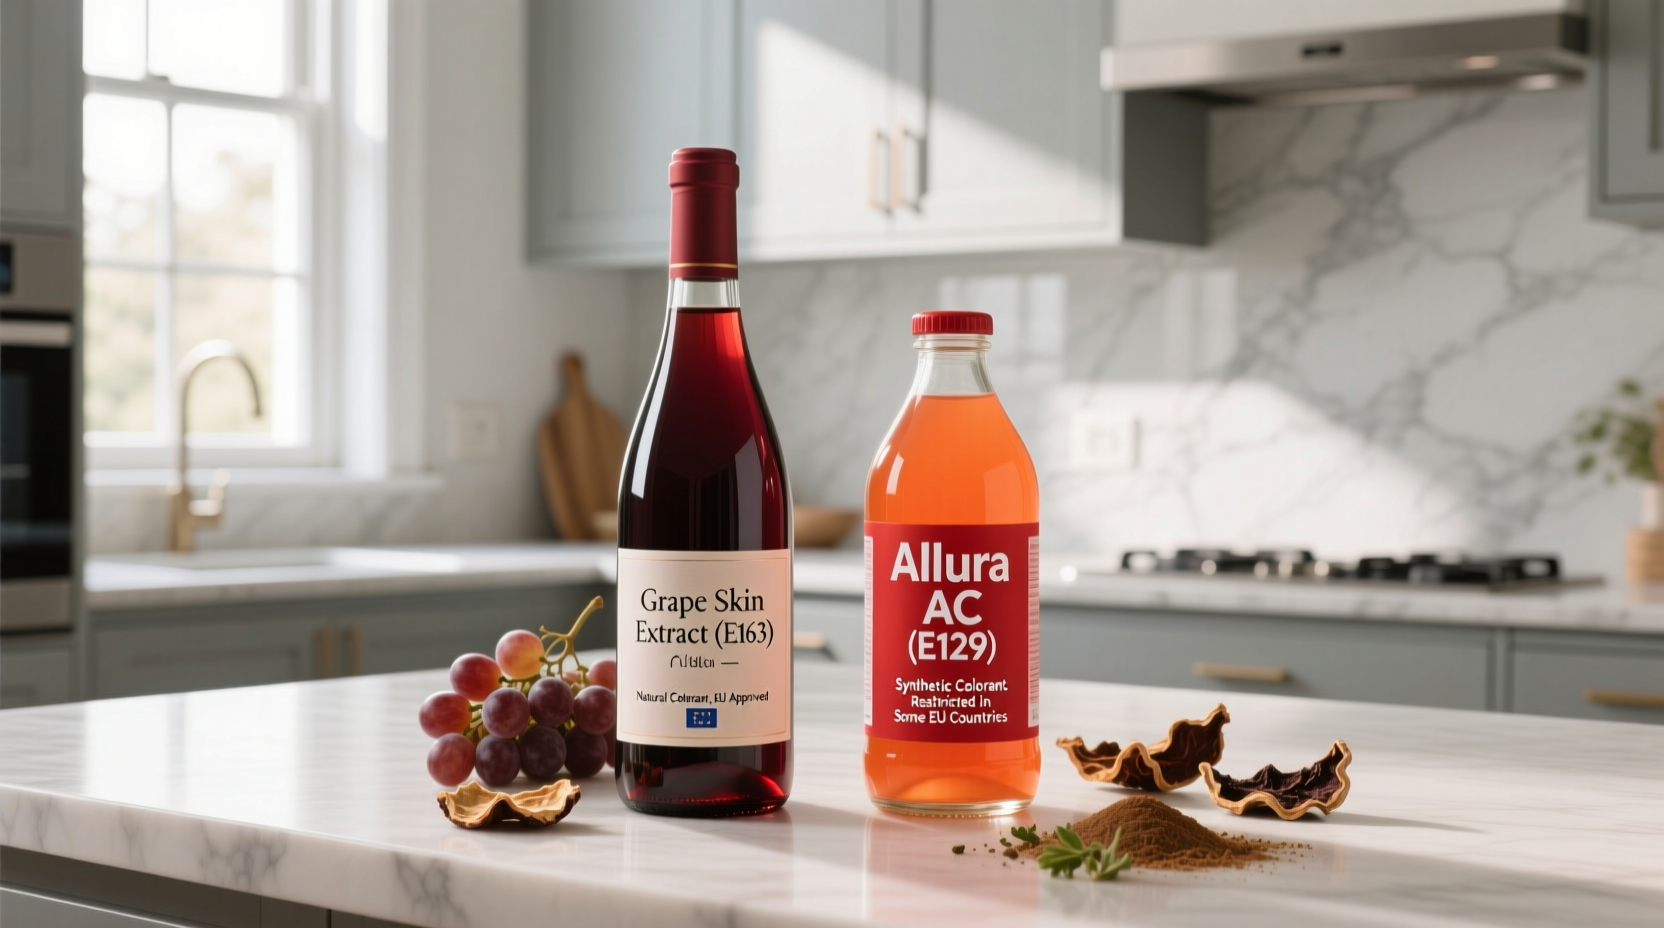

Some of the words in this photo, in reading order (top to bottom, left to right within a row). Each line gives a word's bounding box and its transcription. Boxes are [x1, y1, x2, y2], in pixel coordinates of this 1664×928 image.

[890, 541, 1010, 582] Allura
[641, 588, 707, 618] Grape
[714, 588, 764, 612] Skin
[922, 589, 983, 625] AC
[635, 620, 708, 644] Extract
[715, 619, 773, 649] (E163)
[908, 630, 996, 665] (E129)
[714, 692, 726, 703] EU
[895, 678, 951, 695] Synthetic
[955, 678, 1008, 692] Colorant
[929, 711, 946, 723] EU
[949, 710, 1008, 723] Countries
